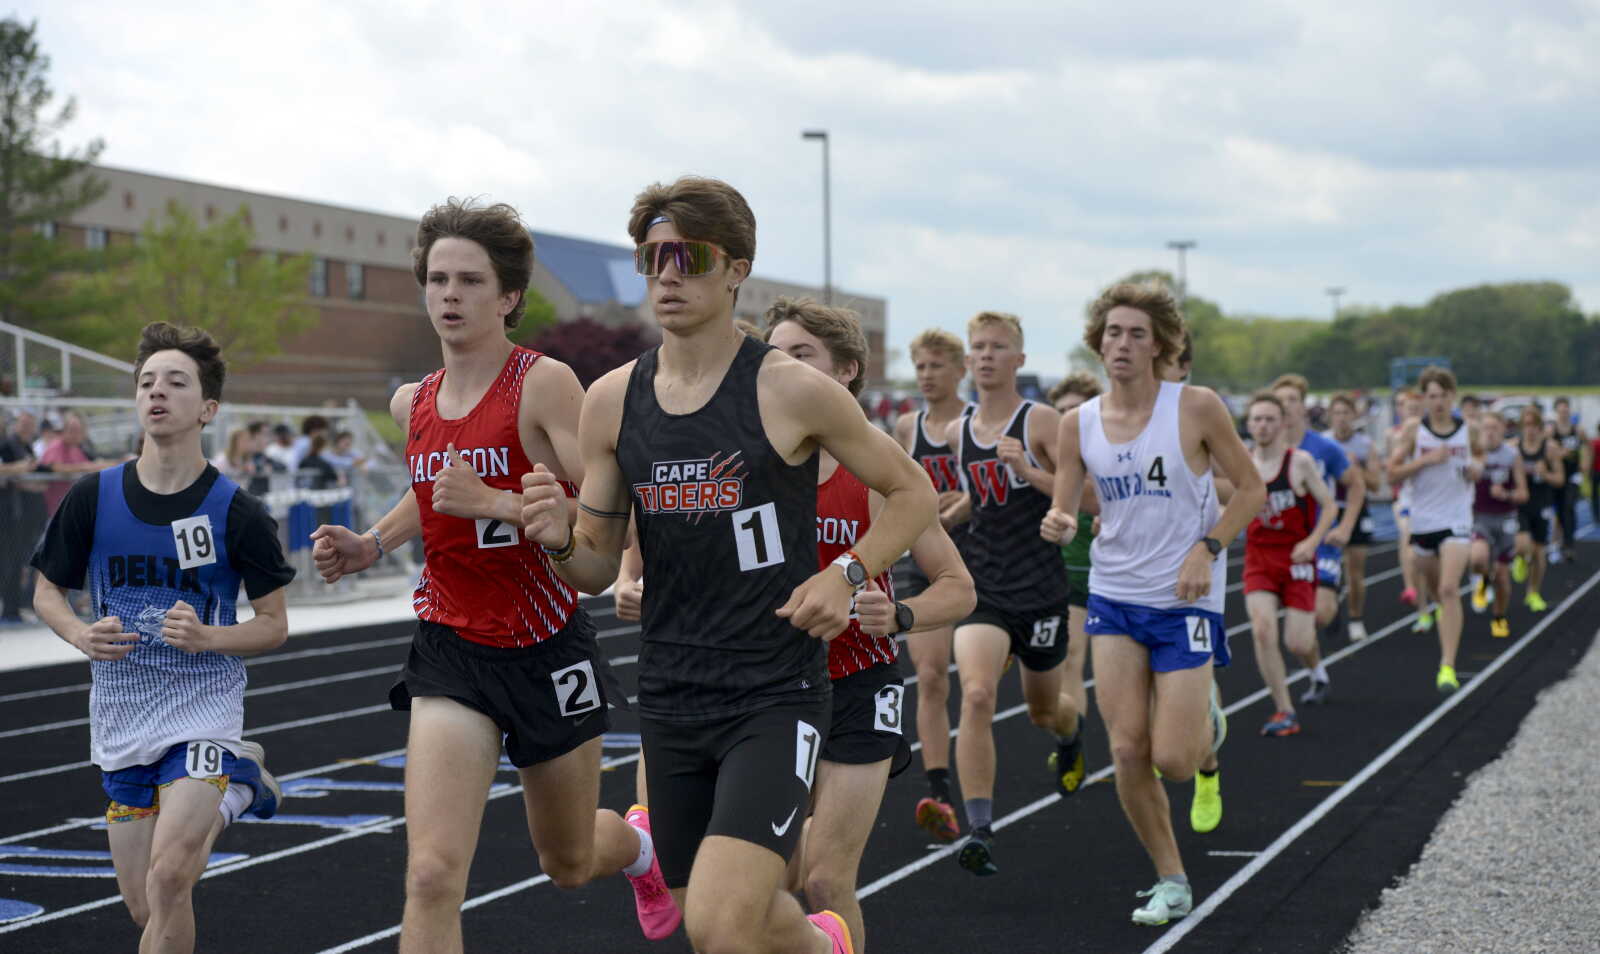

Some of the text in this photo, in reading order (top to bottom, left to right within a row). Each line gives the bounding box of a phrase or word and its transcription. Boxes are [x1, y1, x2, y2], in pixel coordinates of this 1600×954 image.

[655, 463, 708, 483] CAPE
[1147, 456, 1167, 487] 4
[636, 479, 741, 511] TIGERS
[176, 525, 211, 561] 19
[741, 511, 768, 564] 1
[1037, 620, 1053, 644] 5
[1193, 618, 1208, 648] 4
[558, 669, 595, 713] 2
[879, 687, 900, 728] 3
[190, 743, 220, 774] 19
[803, 732, 817, 781] 1
